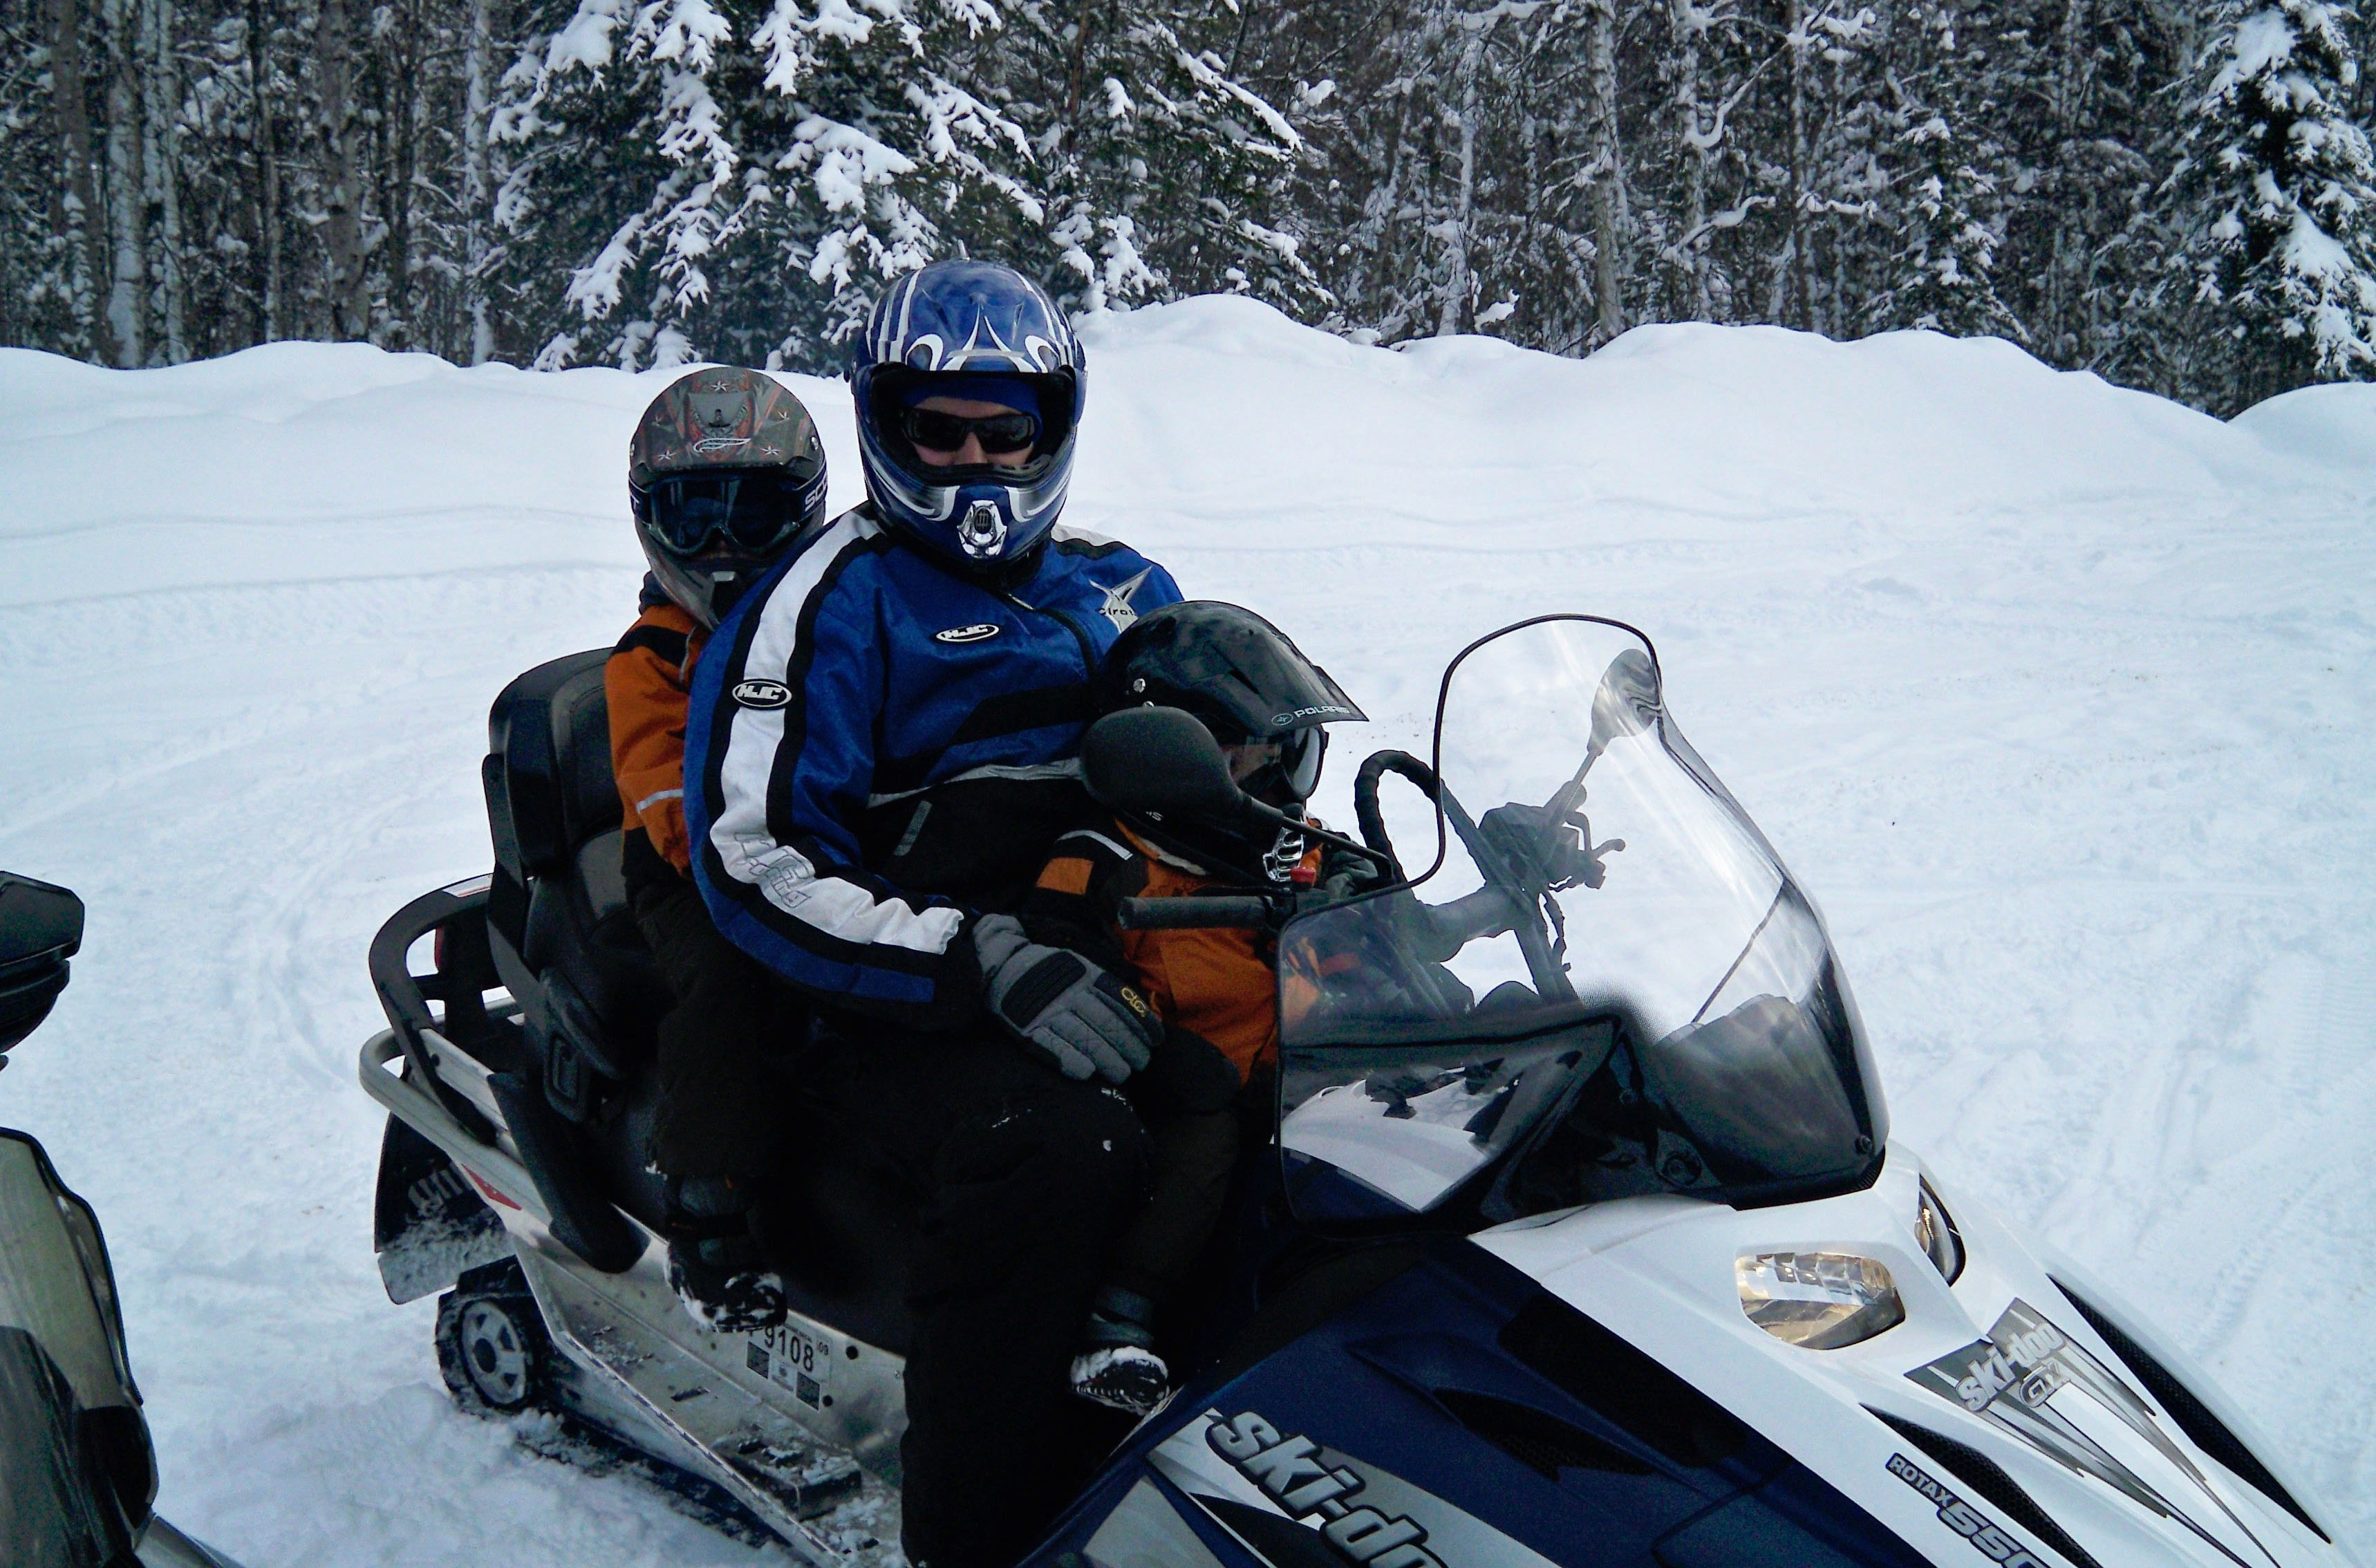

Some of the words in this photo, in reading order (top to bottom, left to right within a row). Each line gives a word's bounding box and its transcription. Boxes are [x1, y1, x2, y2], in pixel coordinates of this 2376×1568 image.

[942, 624, 989, 639] HJC
[736, 685, 783, 700] HJC
[1293, 705, 1350, 718] POLARIS
[1887, 1455, 1954, 1506] ROTAX
